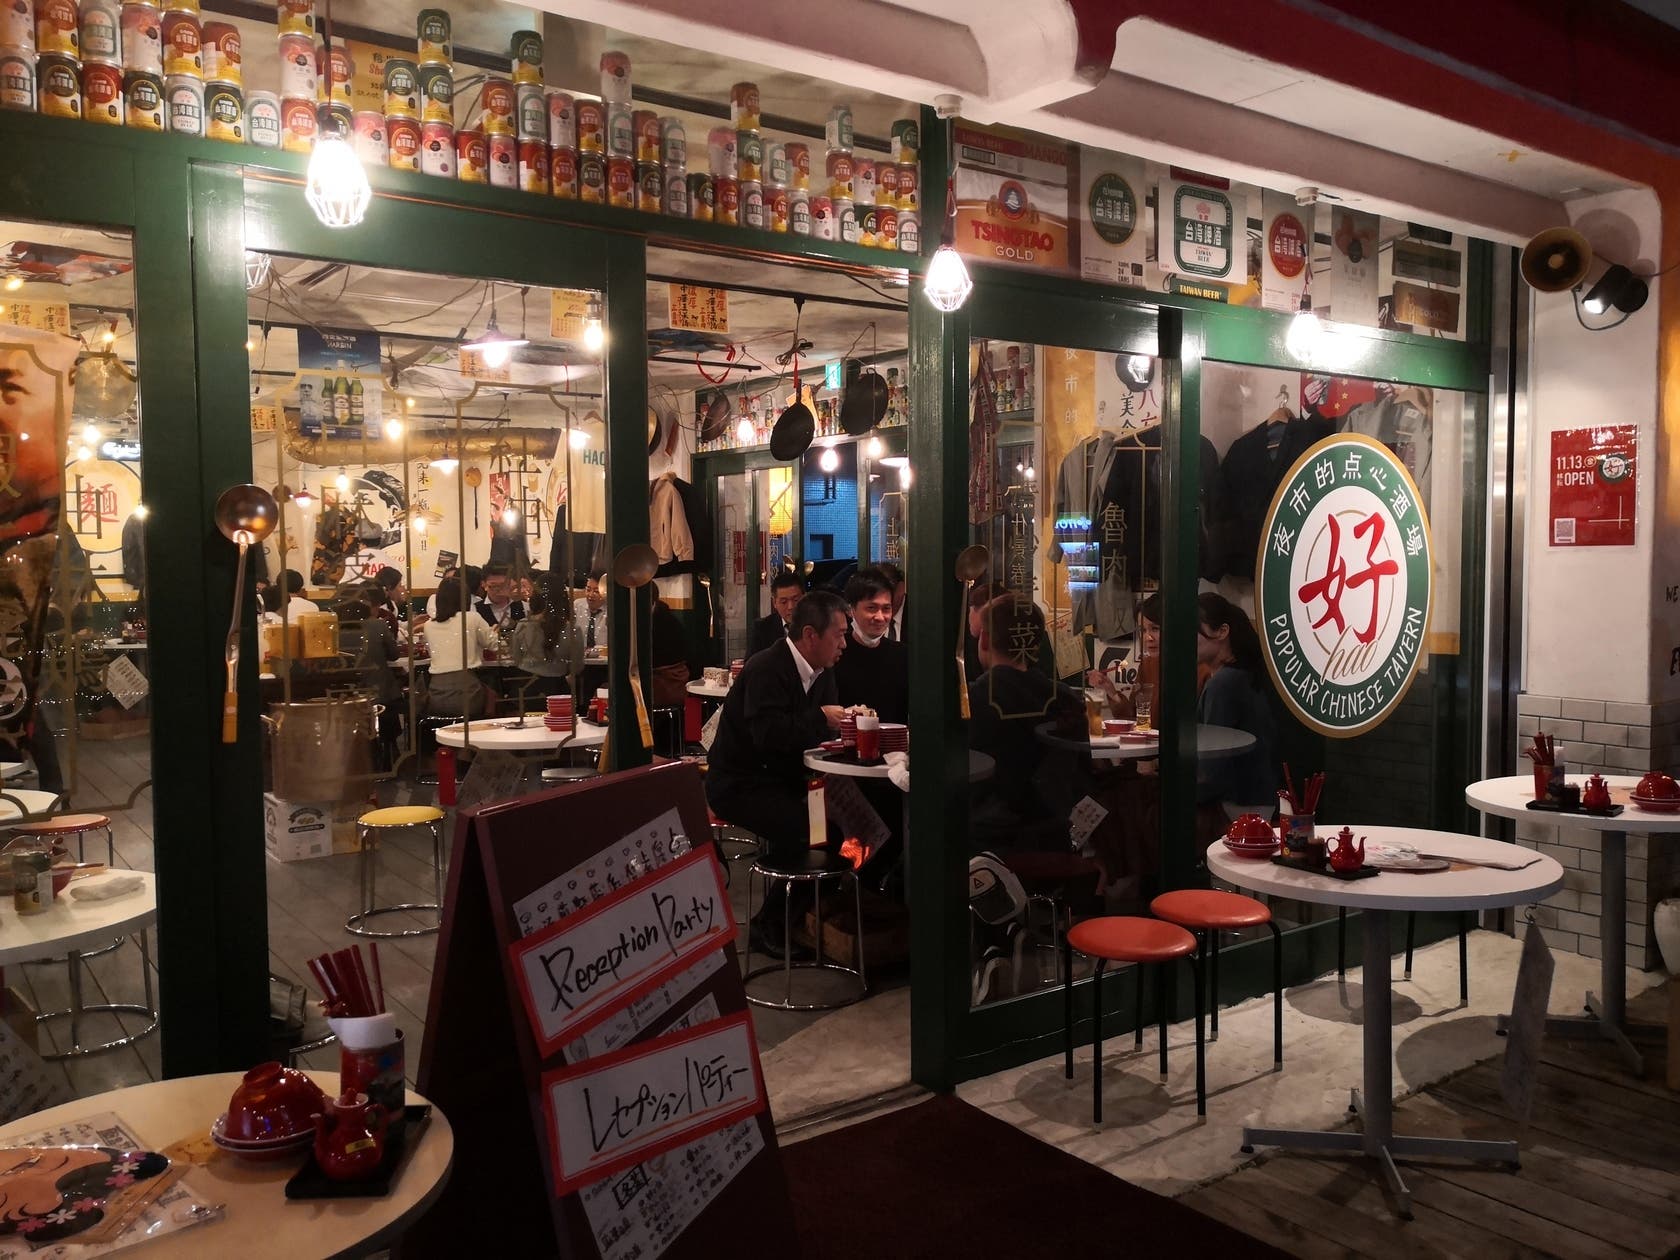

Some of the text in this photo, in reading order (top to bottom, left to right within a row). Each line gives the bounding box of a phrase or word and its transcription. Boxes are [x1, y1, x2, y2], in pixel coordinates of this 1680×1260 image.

[971, 220, 1054, 251] TSINGTAO
[996, 245, 1034, 261] GOLD
[1179, 285, 1220, 301] TAIWAN BEER
[1564, 471, 1594, 486] OPEN
[1298, 512, 1399, 644] 好
[1271, 608, 1423, 719] POPULAR CHINESE TAVERN
[540, 893, 713, 1012] Reception Party
